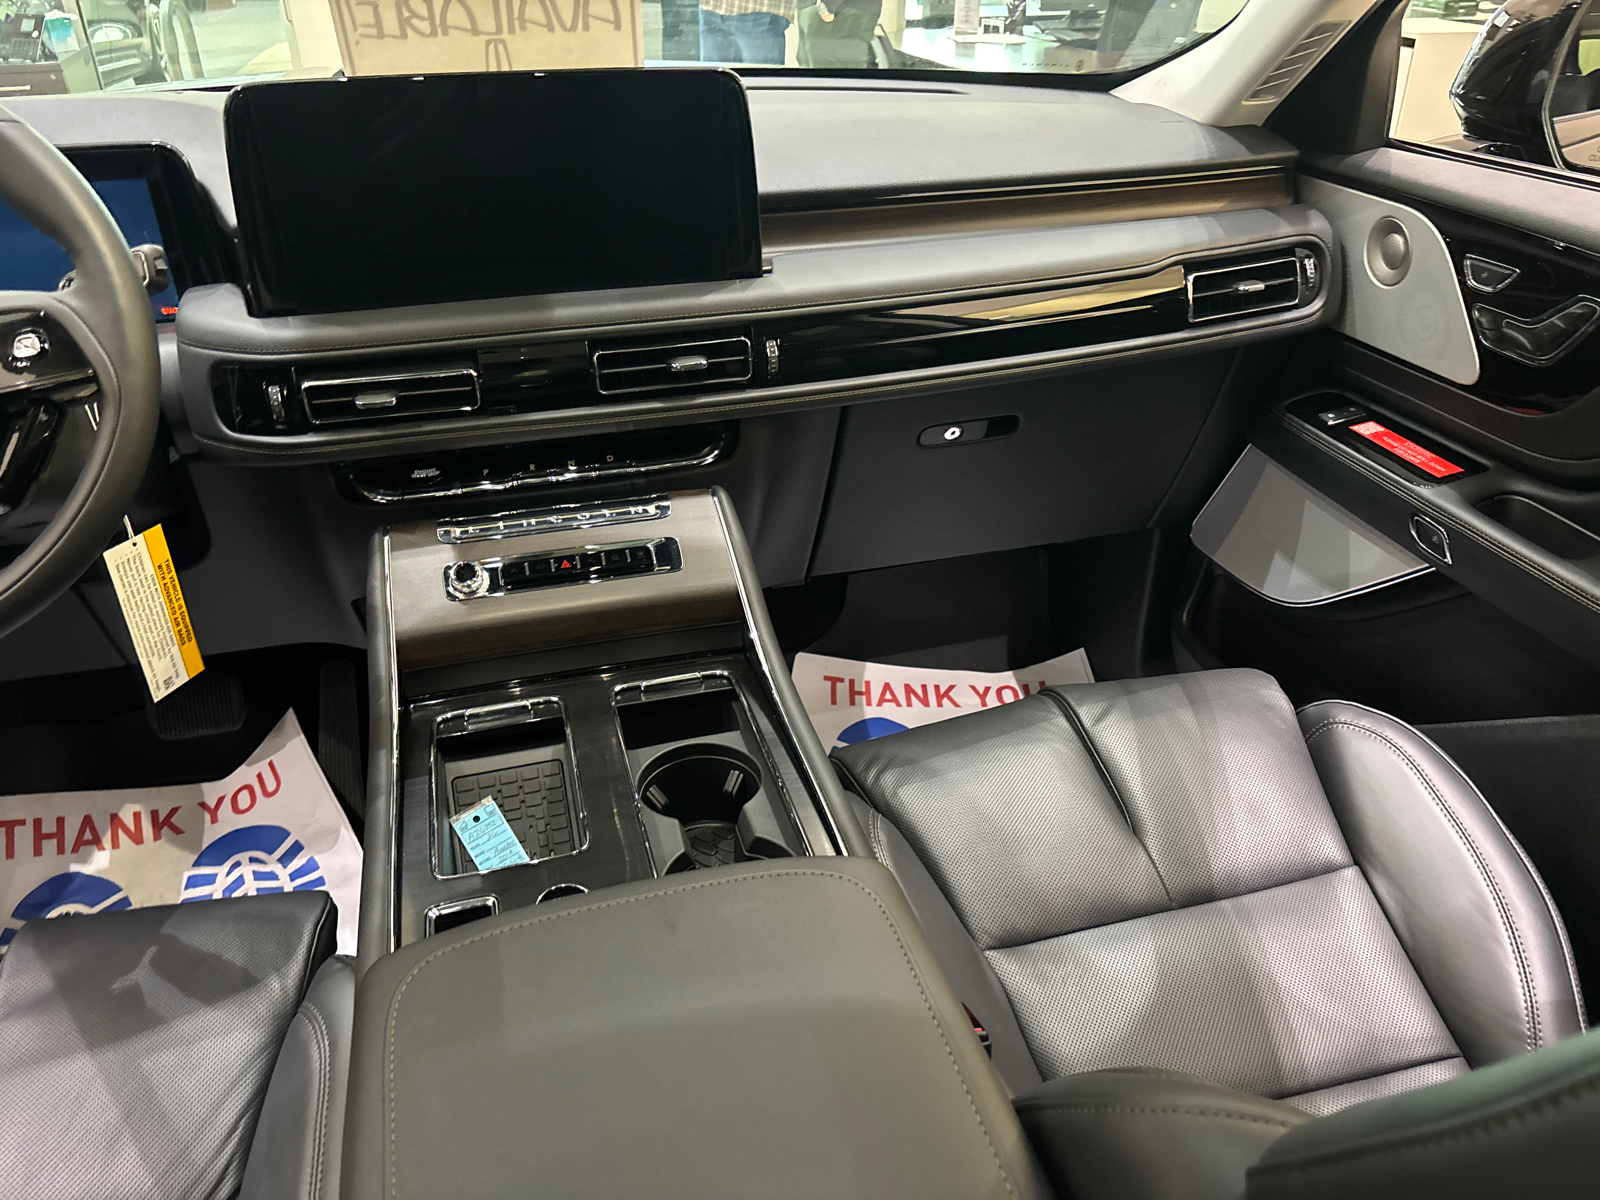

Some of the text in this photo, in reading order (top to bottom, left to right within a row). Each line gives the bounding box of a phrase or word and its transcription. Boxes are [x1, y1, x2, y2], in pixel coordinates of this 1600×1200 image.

[482, 468, 489, 476] P
[529, 463, 536, 471] R
[606, 454, 614, 462] D
[156, 563, 166, 581] WITH
[162, 581, 177, 616] ADVANCED
[177, 627, 186, 646] BAGS
[163, 558, 193, 642] THIS VEHICLE IS EQUIPPED
[823, 675, 963, 708] THANK
[0, 759, 282, 860] THANK YOU
